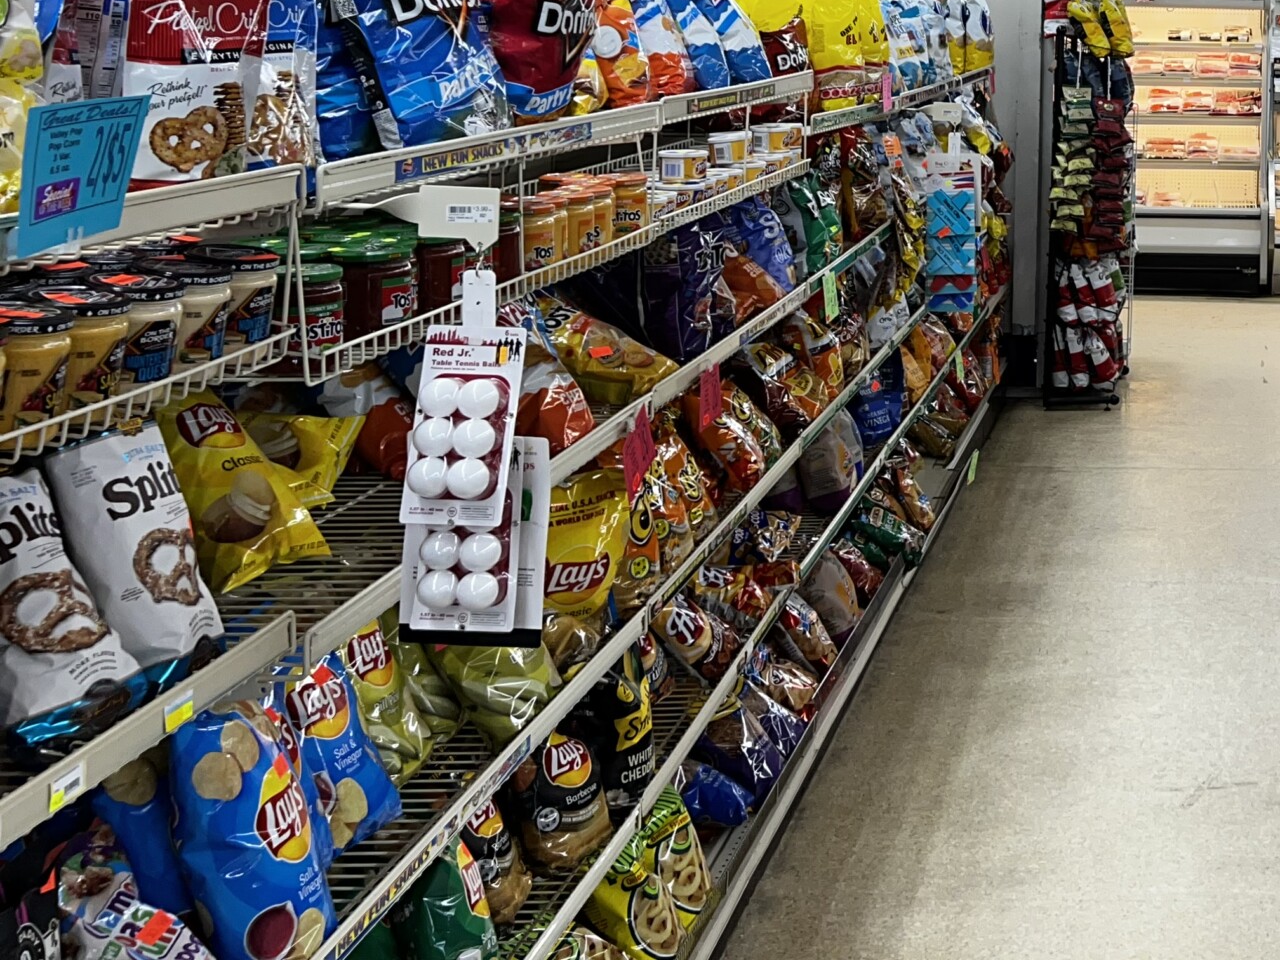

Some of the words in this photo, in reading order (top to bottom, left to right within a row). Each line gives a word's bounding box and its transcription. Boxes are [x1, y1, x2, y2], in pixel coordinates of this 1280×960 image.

[143, 0, 215, 34] Pretzel
[147, 78, 192, 96] Rethink
[43, 111, 82, 128] Great
[86, 101, 140, 120] Deals!
[149, 99, 165, 110] our
[525, 89, 567, 113] Party
[423, 153, 448, 171] NEW
[450, 149, 470, 167] FUN
[471, 143, 504, 163] SNACKS
[432, 348, 453, 357] Red
[454, 360, 480, 368] Tennis
[181, 401, 239, 443] Lay's
[221, 453, 264, 473] Classic
[102, 463, 182, 522] Split
[0, 503, 60, 565] plits
[556, 516, 580, 526] WORLD
[546, 557, 607, 594] Lay's
[302, 676, 343, 727] Lay's
[333, 746, 349, 761] Salt
[335, 747, 363, 773] Vinegar
[551, 740, 584, 777] Lay's
[566, 783, 597, 805] Barbecue
[264, 782, 304, 843] Lay's
[337, 919, 365, 957] NEW
